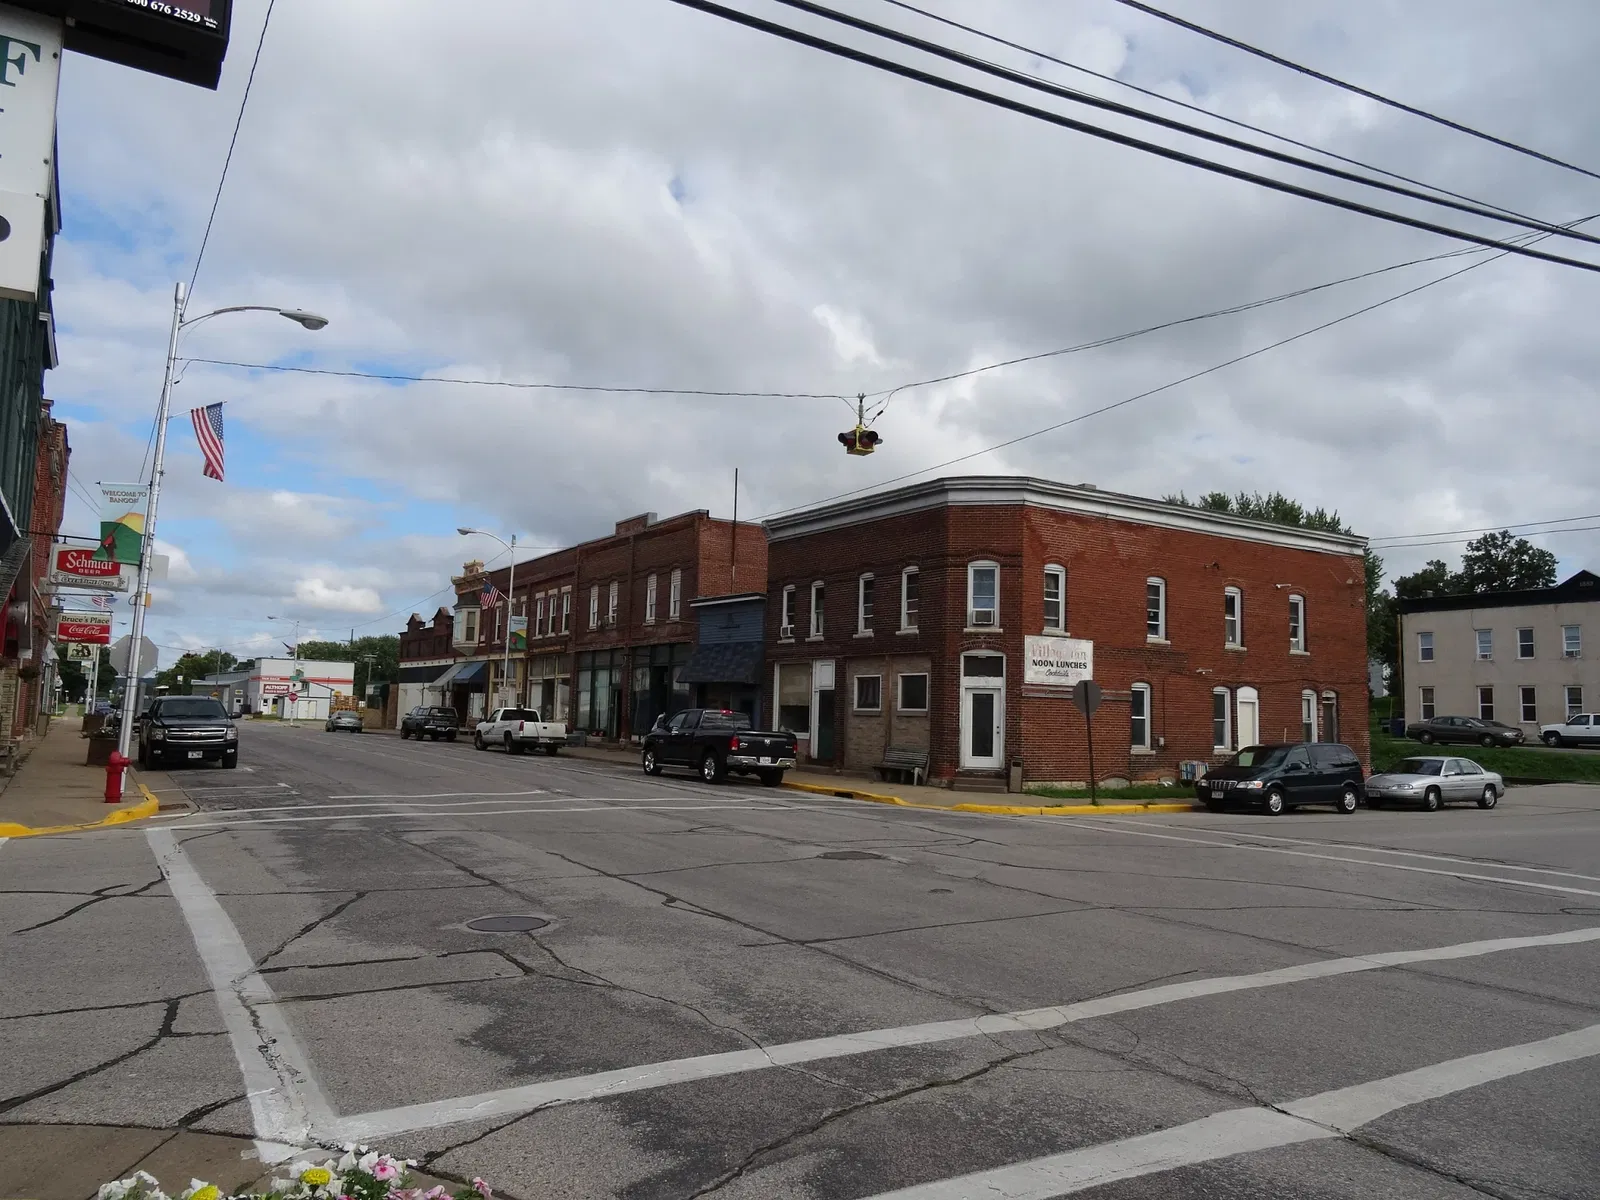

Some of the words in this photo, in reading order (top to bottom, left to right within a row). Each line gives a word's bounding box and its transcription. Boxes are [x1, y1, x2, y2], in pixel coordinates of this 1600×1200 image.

[150, 1, 172, 14] 676
[173, 8, 201, 22] 2529
[101, 489, 136, 498] WELCOME
[61, 615, 89, 623] Bruce's
[1032, 659, 1054, 668] NOON
[1056, 661, 1087, 669] LUNCHES
